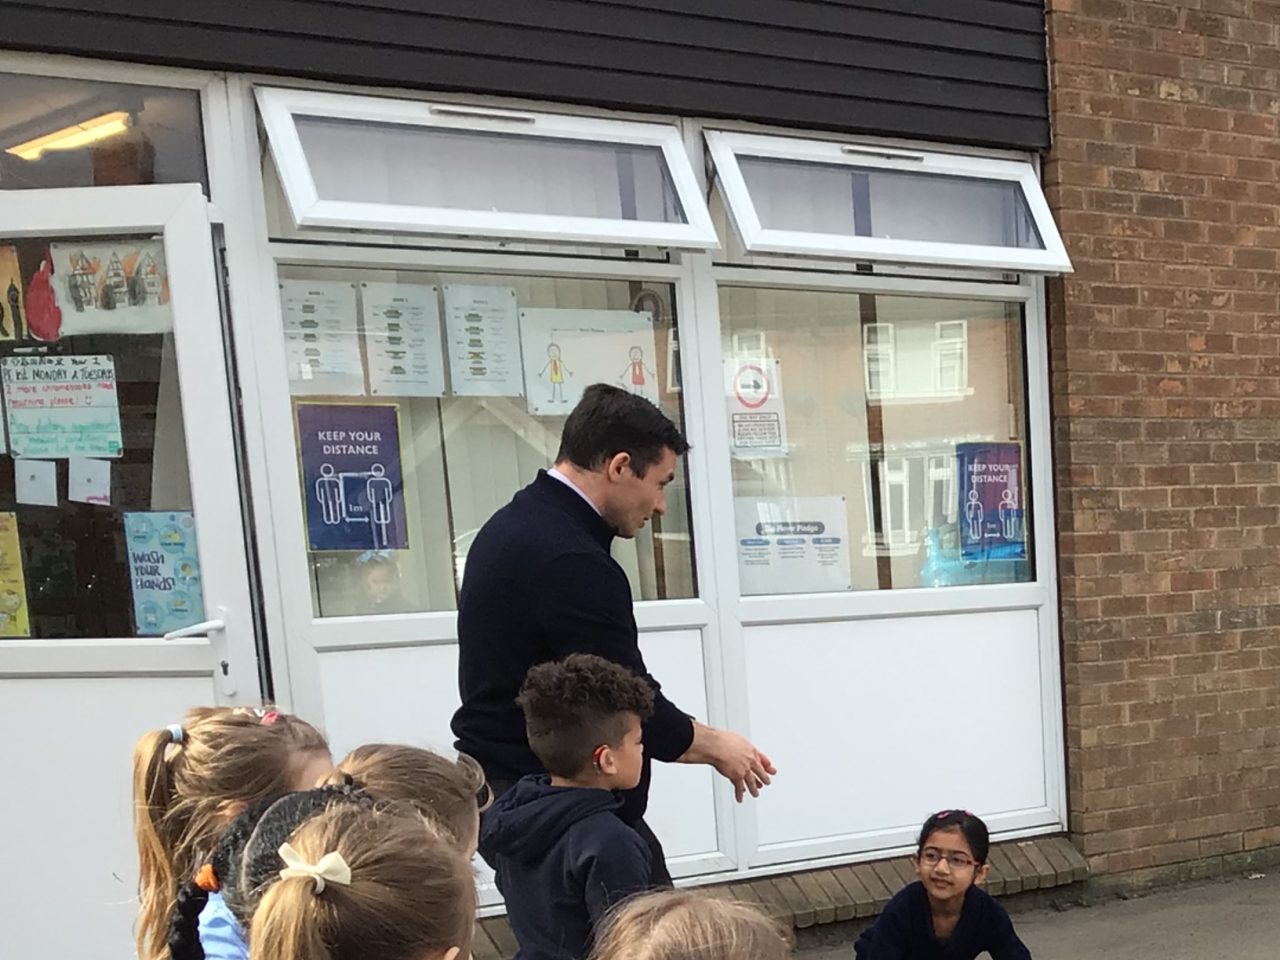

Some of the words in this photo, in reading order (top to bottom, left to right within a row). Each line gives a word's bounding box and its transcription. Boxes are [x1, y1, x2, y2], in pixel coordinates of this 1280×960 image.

[32, 368, 67, 380] MONDAY
[318, 431, 346, 441] KEEP
[348, 431, 382, 441] YOUR
[323, 445, 379, 455] DISTANCE
[968, 464, 987, 472] KEEP
[988, 464, 1011, 472] YOUR
[971, 475, 1008, 483] DISTANCE
[349, 504, 363, 512] 1m
[134, 565, 161, 576] YOUR
